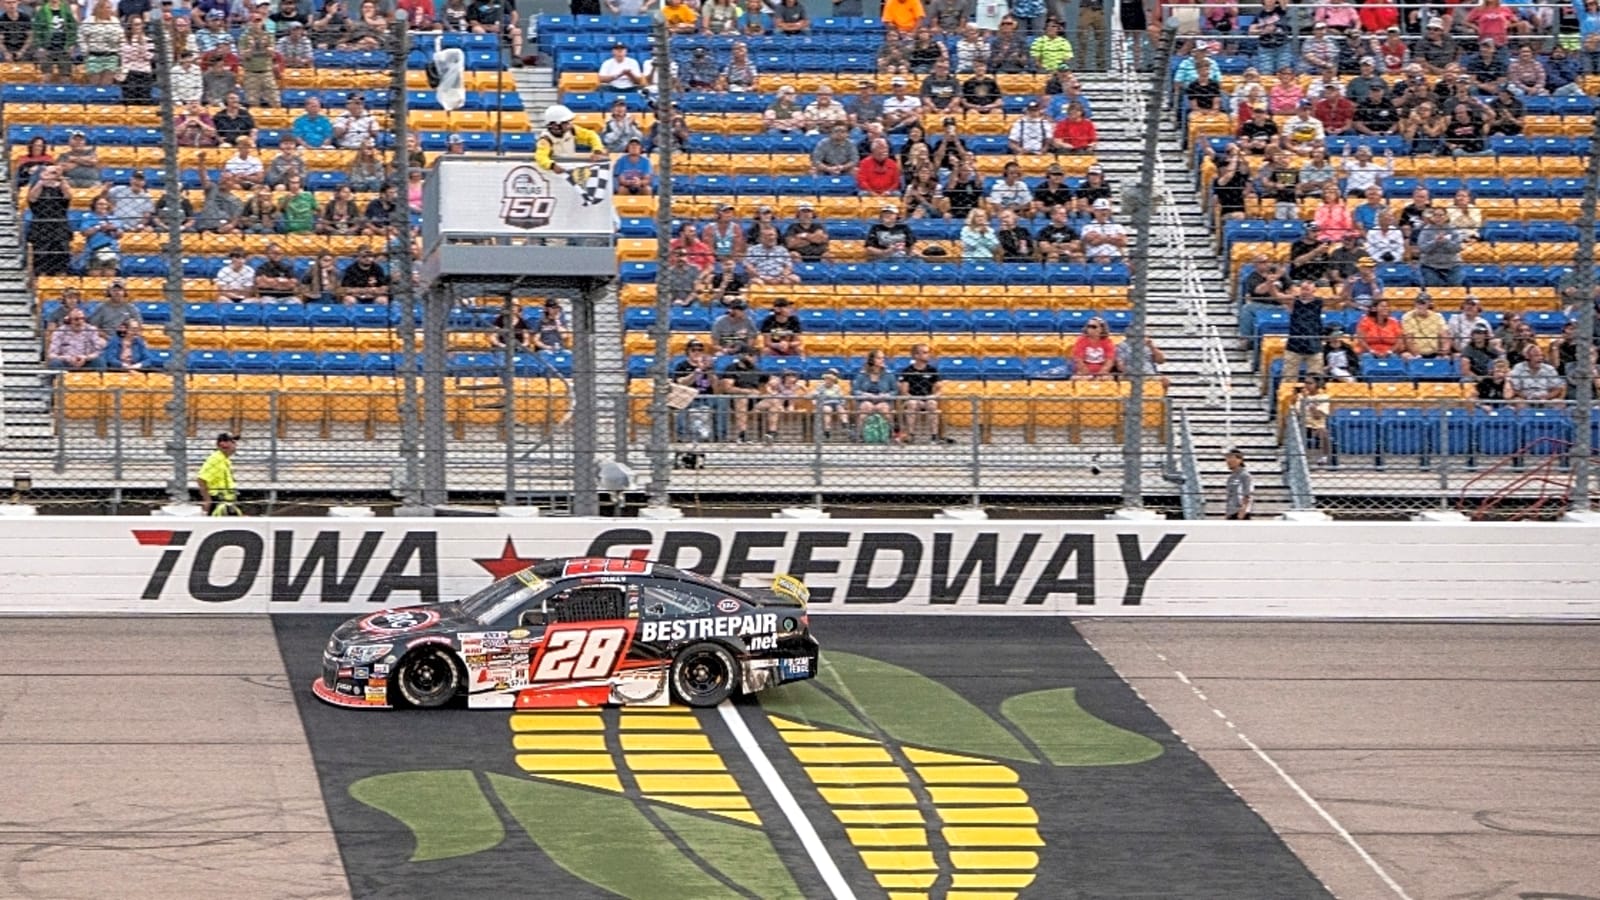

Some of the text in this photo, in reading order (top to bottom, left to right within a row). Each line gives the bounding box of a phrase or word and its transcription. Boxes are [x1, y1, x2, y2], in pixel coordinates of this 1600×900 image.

[500, 198, 557, 218] 150
[132, 529, 440, 603] IOWA
[641, 613, 778, 643] BESTREPAIR
[745, 633, 778, 651] .net
[531, 627, 627, 681] 28
